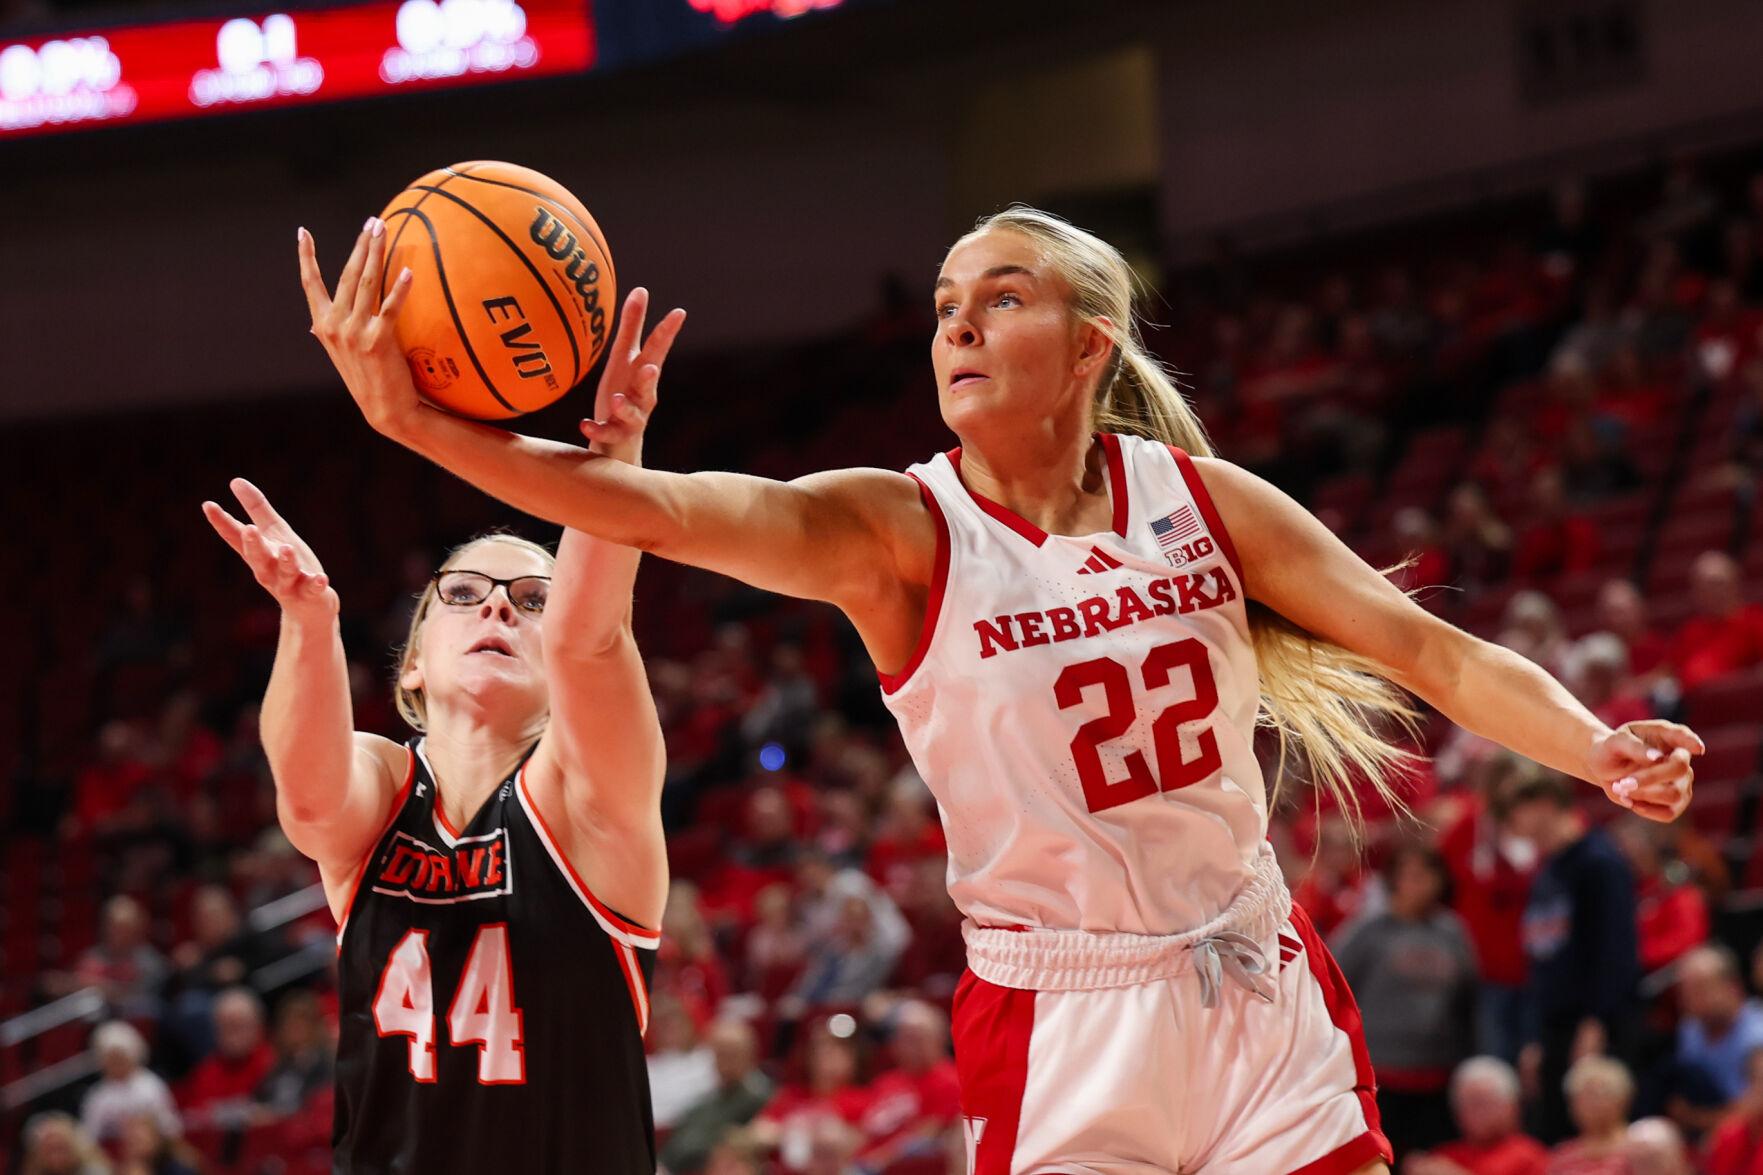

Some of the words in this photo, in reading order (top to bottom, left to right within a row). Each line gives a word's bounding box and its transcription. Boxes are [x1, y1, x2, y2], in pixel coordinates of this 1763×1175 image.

[482, 296, 552, 380] EVO
[530, 206, 605, 365] Wilson
[973, 566, 1236, 660] NEBRASKA
[1053, 637, 1223, 815] 22
[371, 921, 528, 1086] 44
